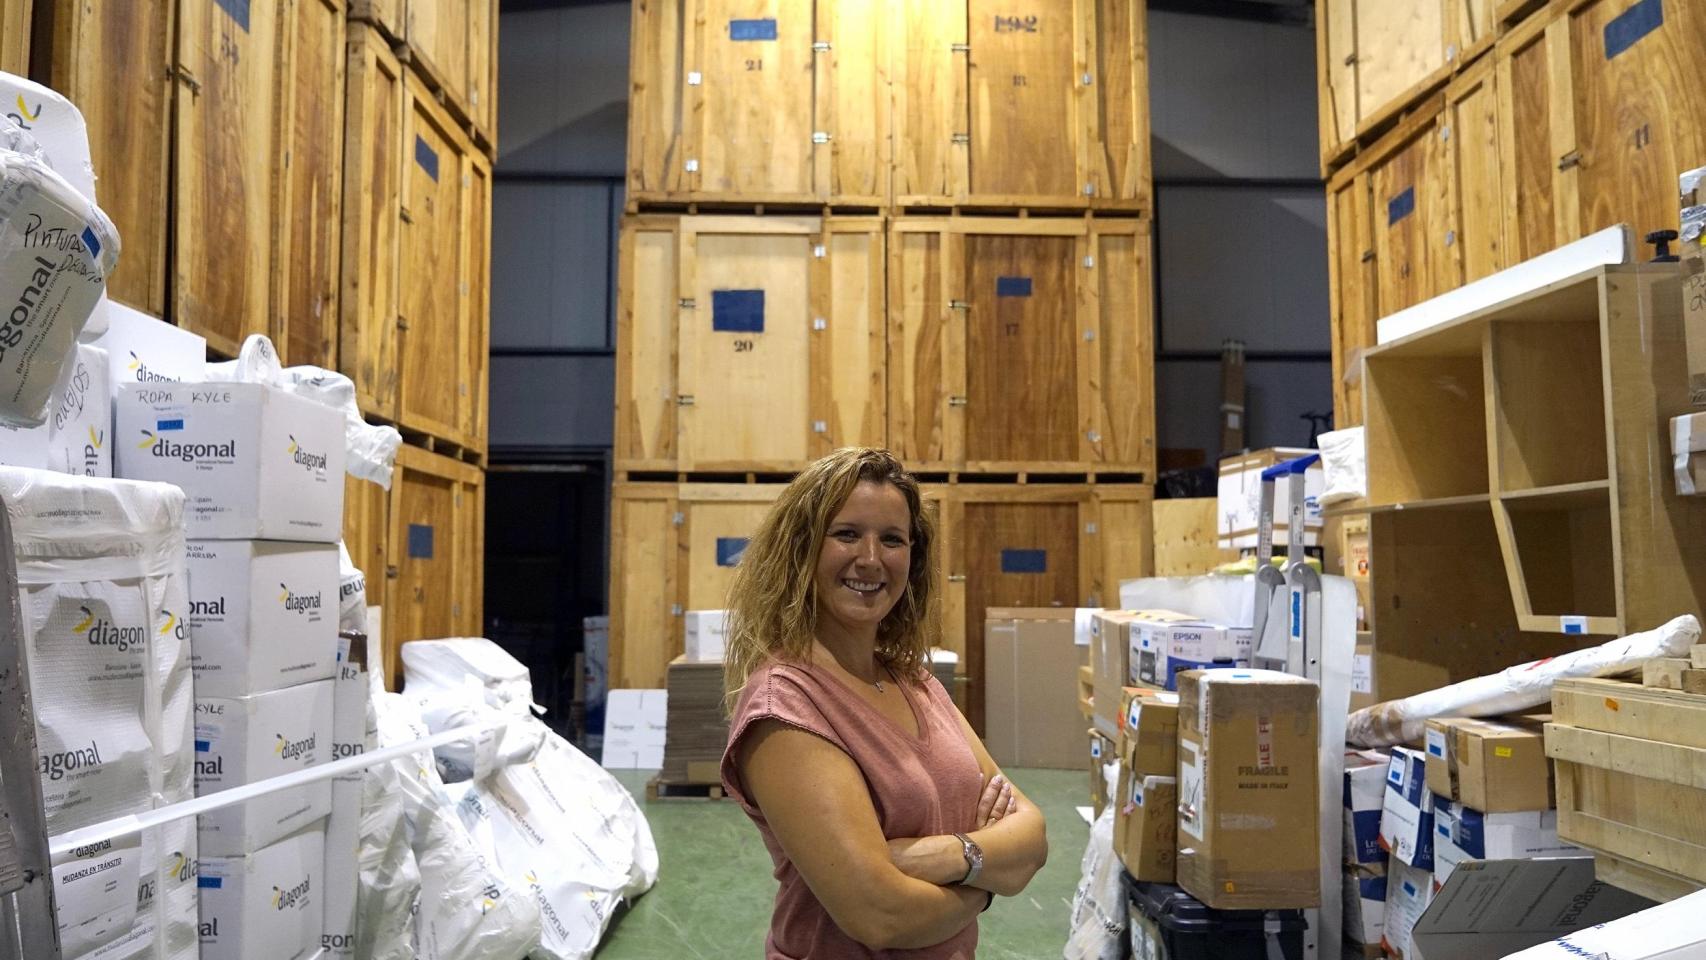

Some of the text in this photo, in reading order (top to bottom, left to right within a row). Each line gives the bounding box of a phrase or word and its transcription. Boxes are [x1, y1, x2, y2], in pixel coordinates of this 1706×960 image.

[744, 58, 763, 72] 21
[733, 339, 754, 353] 20
[136, 389, 232, 404] ROPA KYLE
[152, 437, 236, 463] diagonal
[294, 444, 328, 471] diagonal
[285, 590, 321, 615] diagonal
[1173, 631, 1202, 641] EPSON
[281, 731, 316, 761] diagonal
[1238, 766, 1289, 777] FRAGILE
[62, 869, 89, 885] MUDANZA
[89, 865, 97, 876] EN
[278, 873, 310, 911] diagonal
